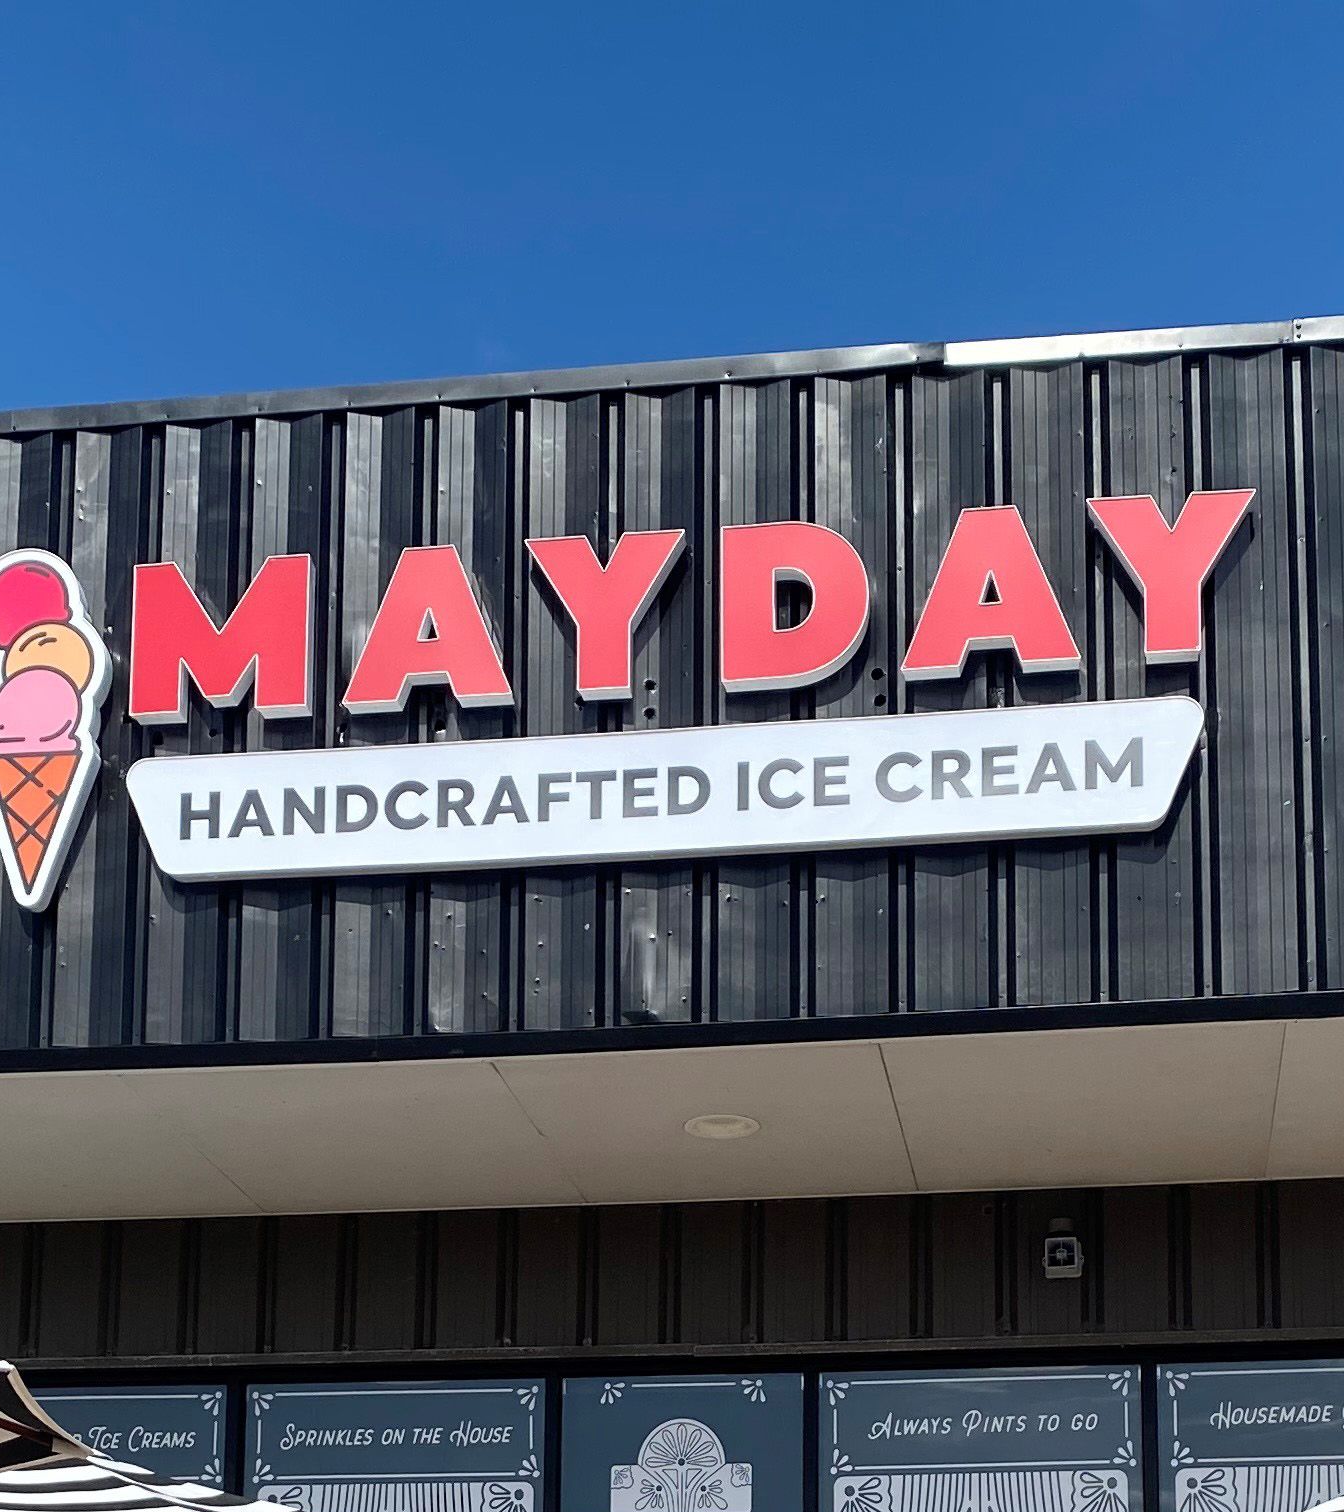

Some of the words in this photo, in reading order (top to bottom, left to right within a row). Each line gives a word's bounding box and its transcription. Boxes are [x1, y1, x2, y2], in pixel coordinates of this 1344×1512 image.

[130, 488, 1254, 722] MAYDAY
[179, 765, 712, 841] HANDCRAFTED
[737, 756, 850, 812] ICE
[875, 737, 1144, 803] CREAM
[867, 1411, 953, 1440] ALWAYS
[962, 1409, 1028, 1437] PINTS
[1038, 1414, 1060, 1432] TO
[1070, 1413, 1098, 1431] GO
[1209, 1401, 1335, 1430] HOUSEMADE
[128, 1426, 197, 1452] CREAMS
[280, 1423, 375, 1450] SPRINKLES
[381, 1428, 406, 1445] ON
[412, 1427, 444, 1445] THE
[450, 1420, 514, 1447] HOUSE
